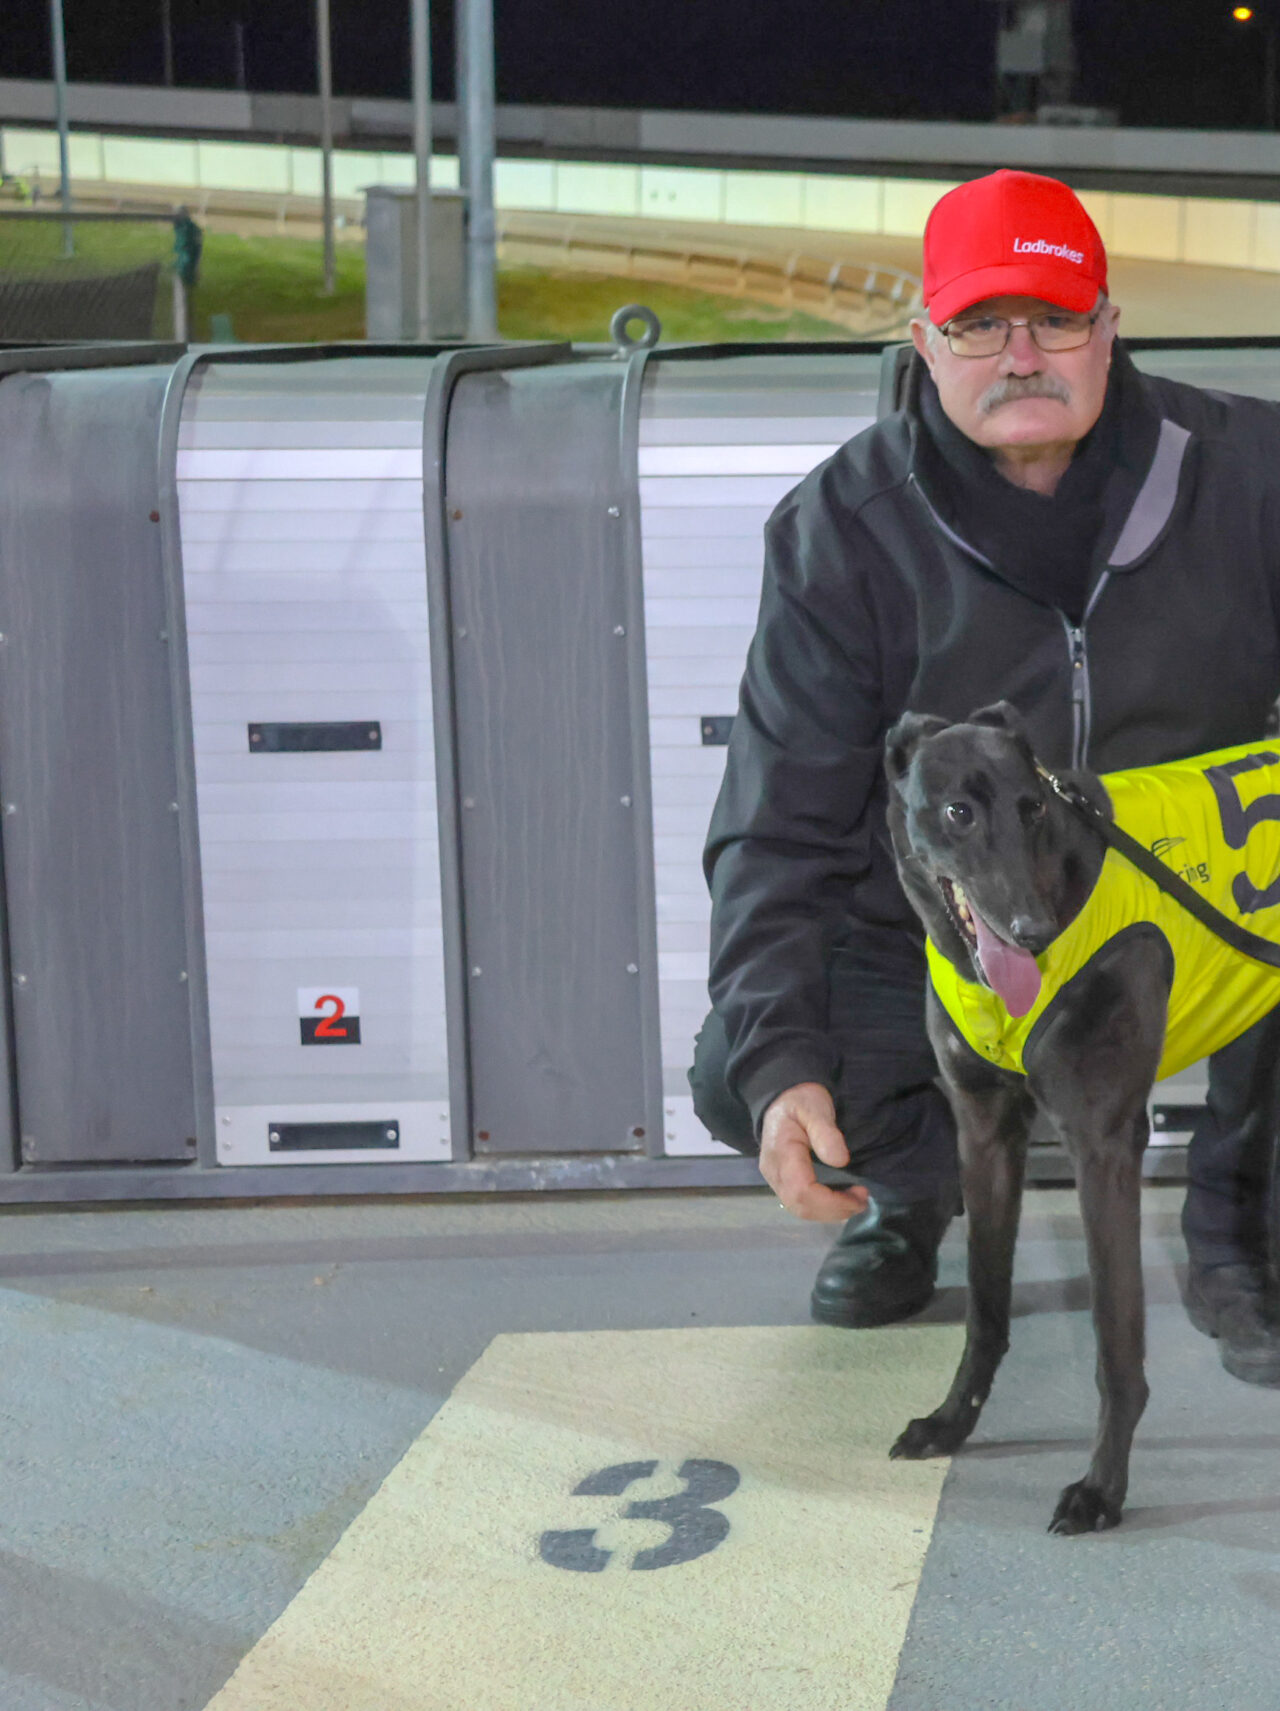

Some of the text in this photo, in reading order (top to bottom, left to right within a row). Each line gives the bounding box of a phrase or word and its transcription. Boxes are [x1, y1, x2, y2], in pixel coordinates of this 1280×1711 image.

[1013, 237, 1084, 264] Ladbrokes
[314, 994, 348, 1037] 2
[540, 1458, 741, 1573] 3
